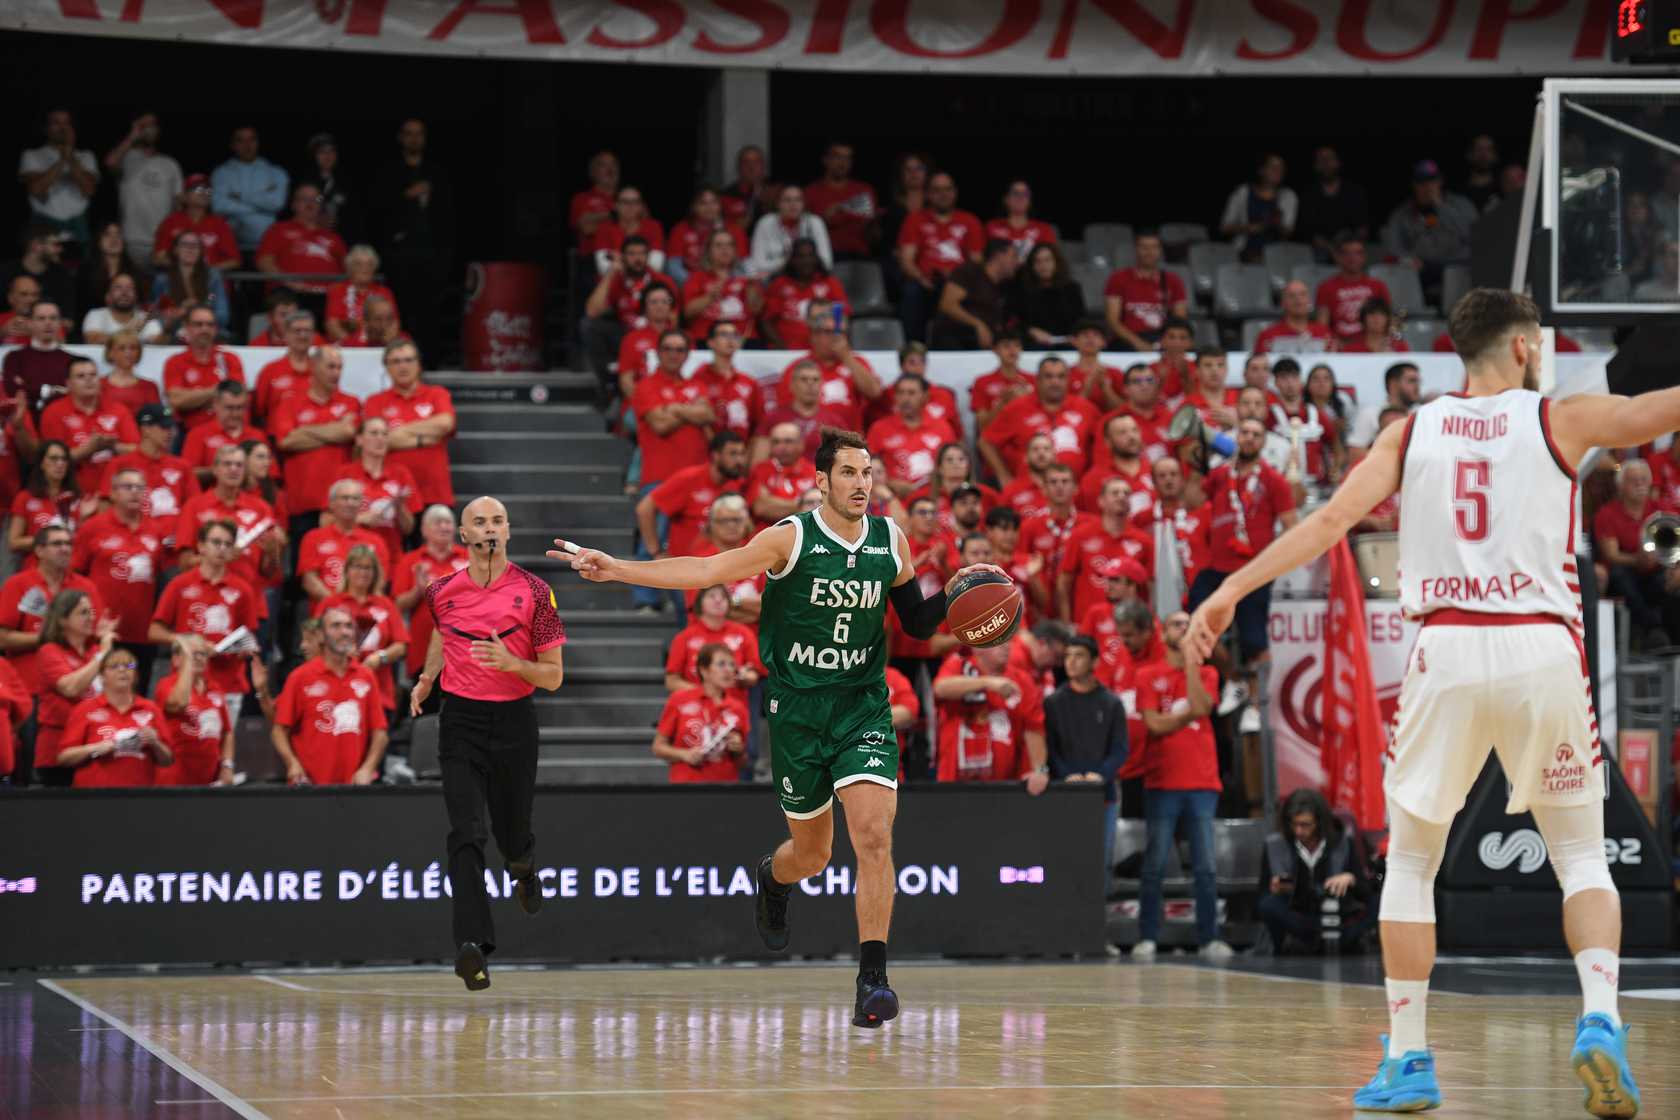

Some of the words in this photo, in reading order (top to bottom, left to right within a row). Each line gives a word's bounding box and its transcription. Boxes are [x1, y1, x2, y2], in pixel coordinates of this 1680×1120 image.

[1453, 456, 1491, 543] 5
[810, 577, 882, 609] ESSM
[1421, 571, 1545, 602] FORMAP
[832, 612, 852, 644] 6
[965, 613, 1007, 640] Betclic
[1270, 612, 1327, 643] CLU
[787, 641, 873, 671] MOW
[81, 871, 322, 903] PARTENAIRE
[338, 862, 578, 900] D'ÉLÉACE
[594, 867, 641, 897] DE
[655, 866, 758, 897] L'ELA
[799, 864, 959, 896] CHON
